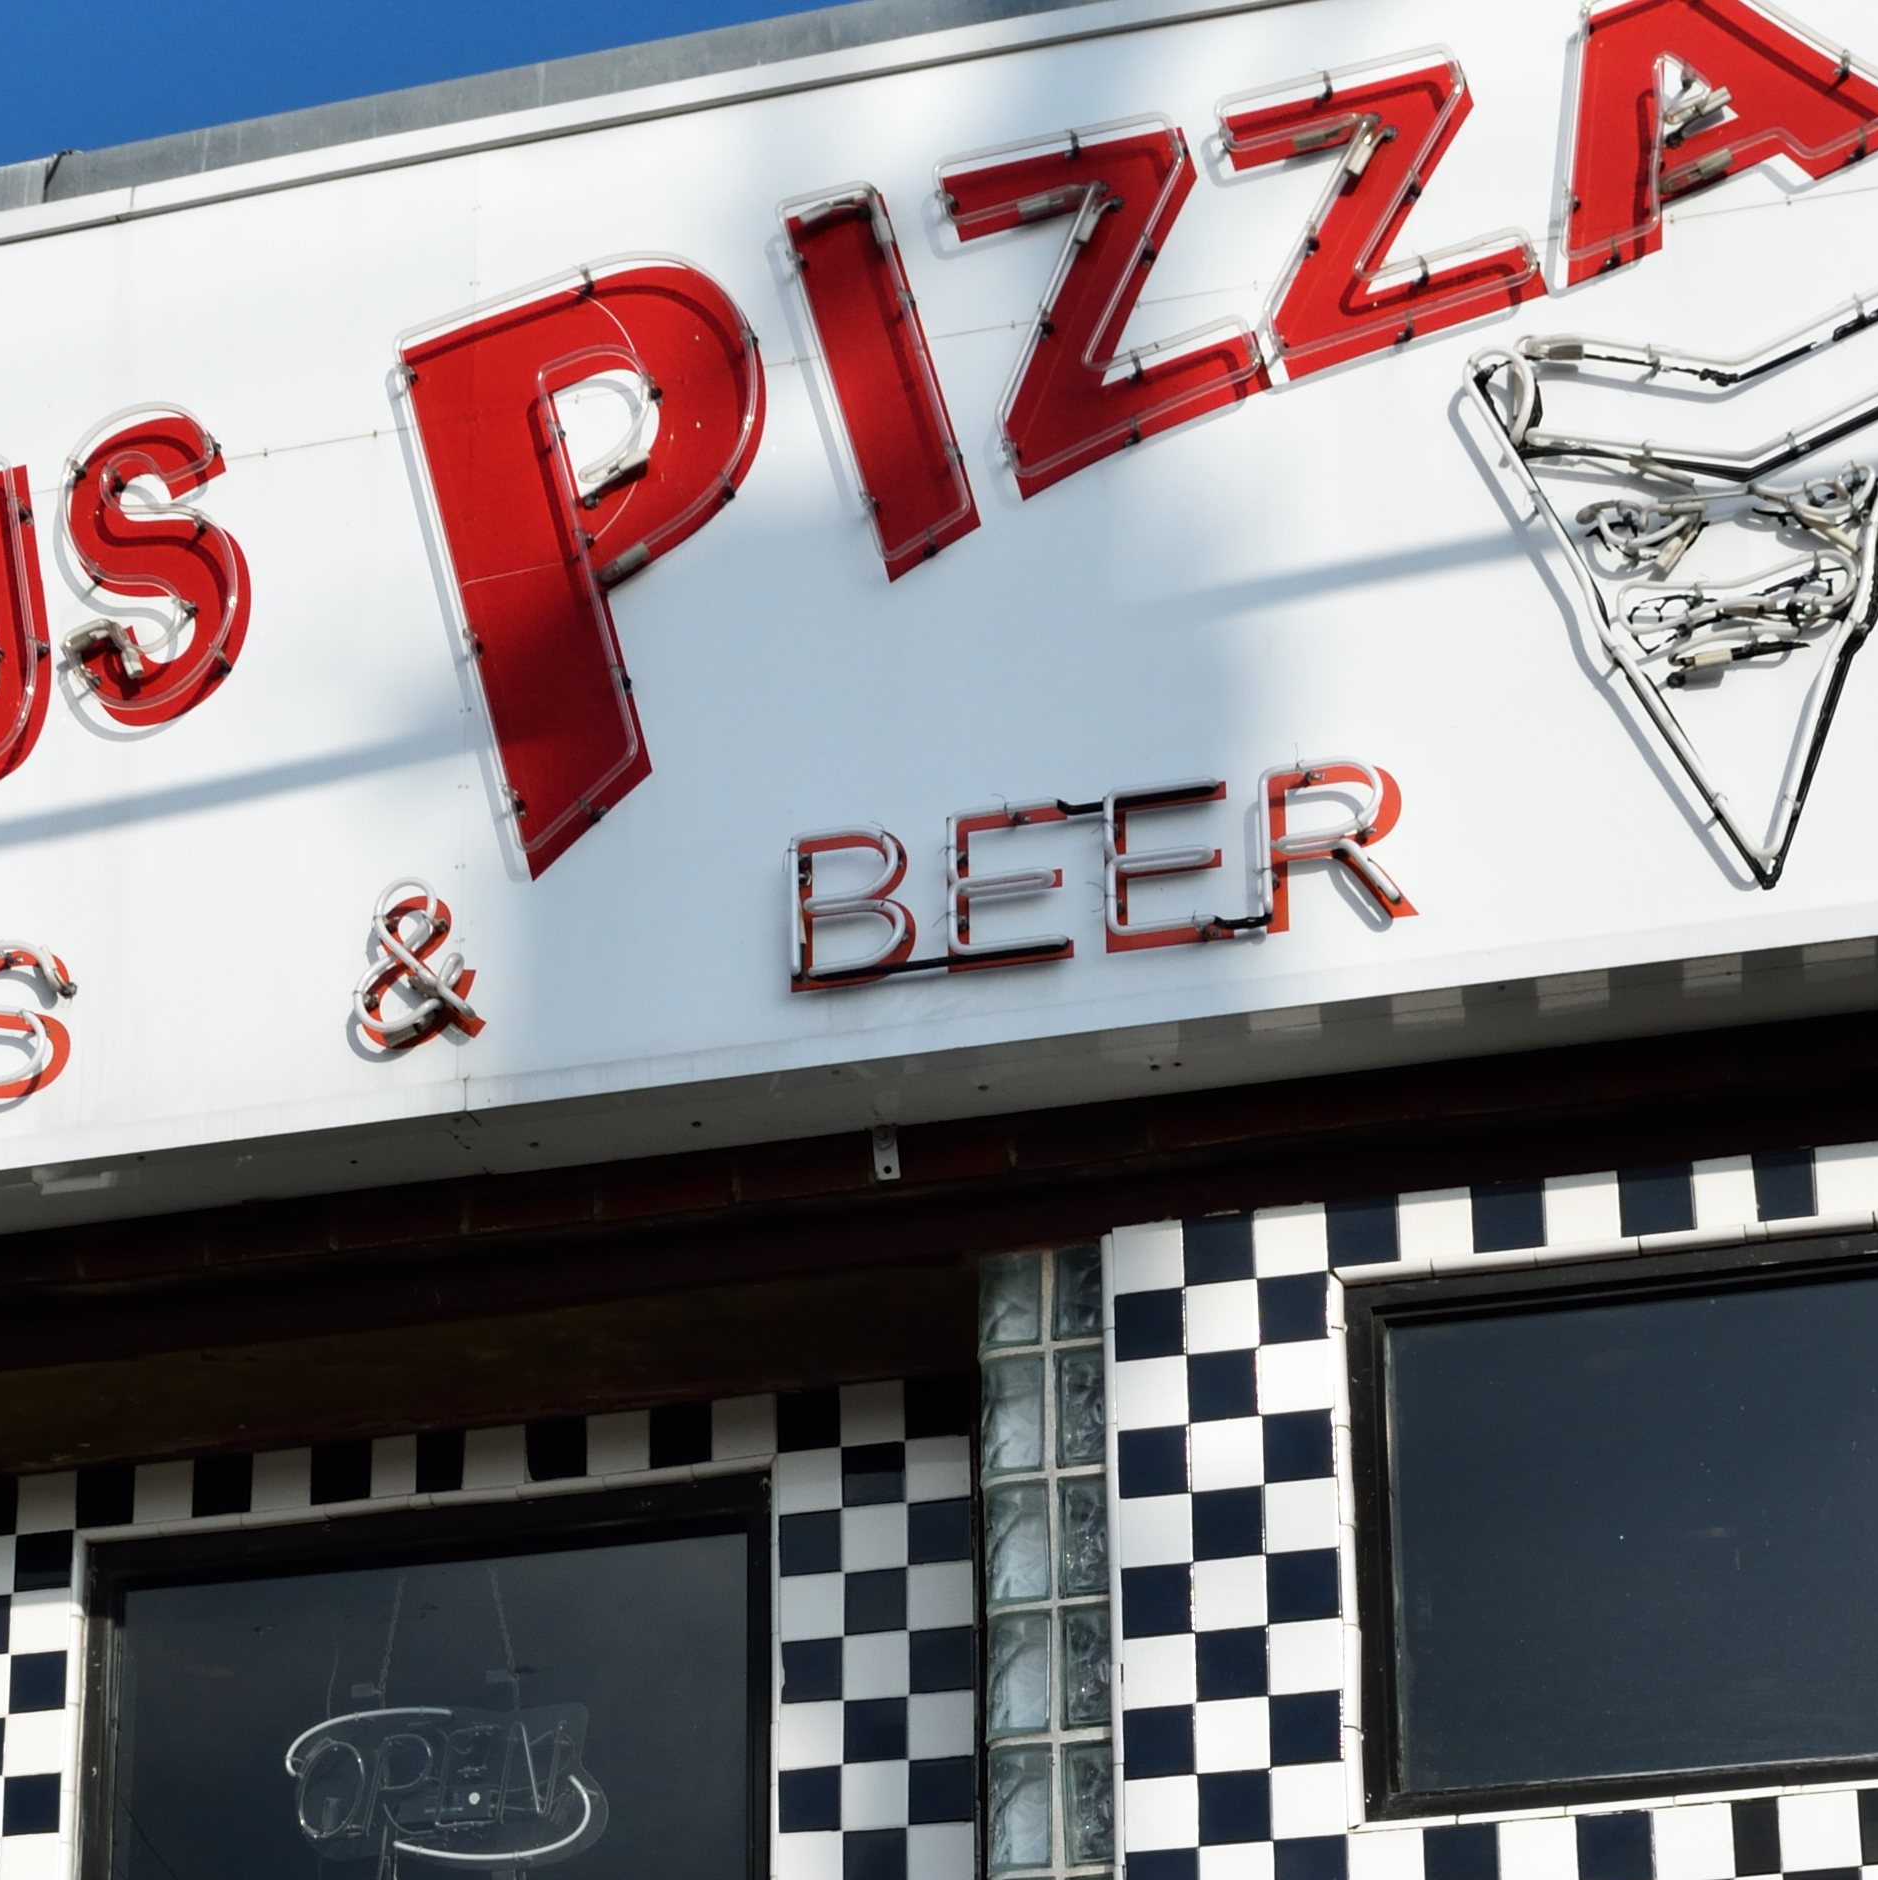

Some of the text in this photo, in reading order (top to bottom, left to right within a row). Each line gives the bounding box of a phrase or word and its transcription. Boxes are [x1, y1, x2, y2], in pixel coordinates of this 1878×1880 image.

[354, 877, 485, 1054] &
[787, 757, 1418, 993] BEER
[298, 1720, 569, 1840] OPEN
